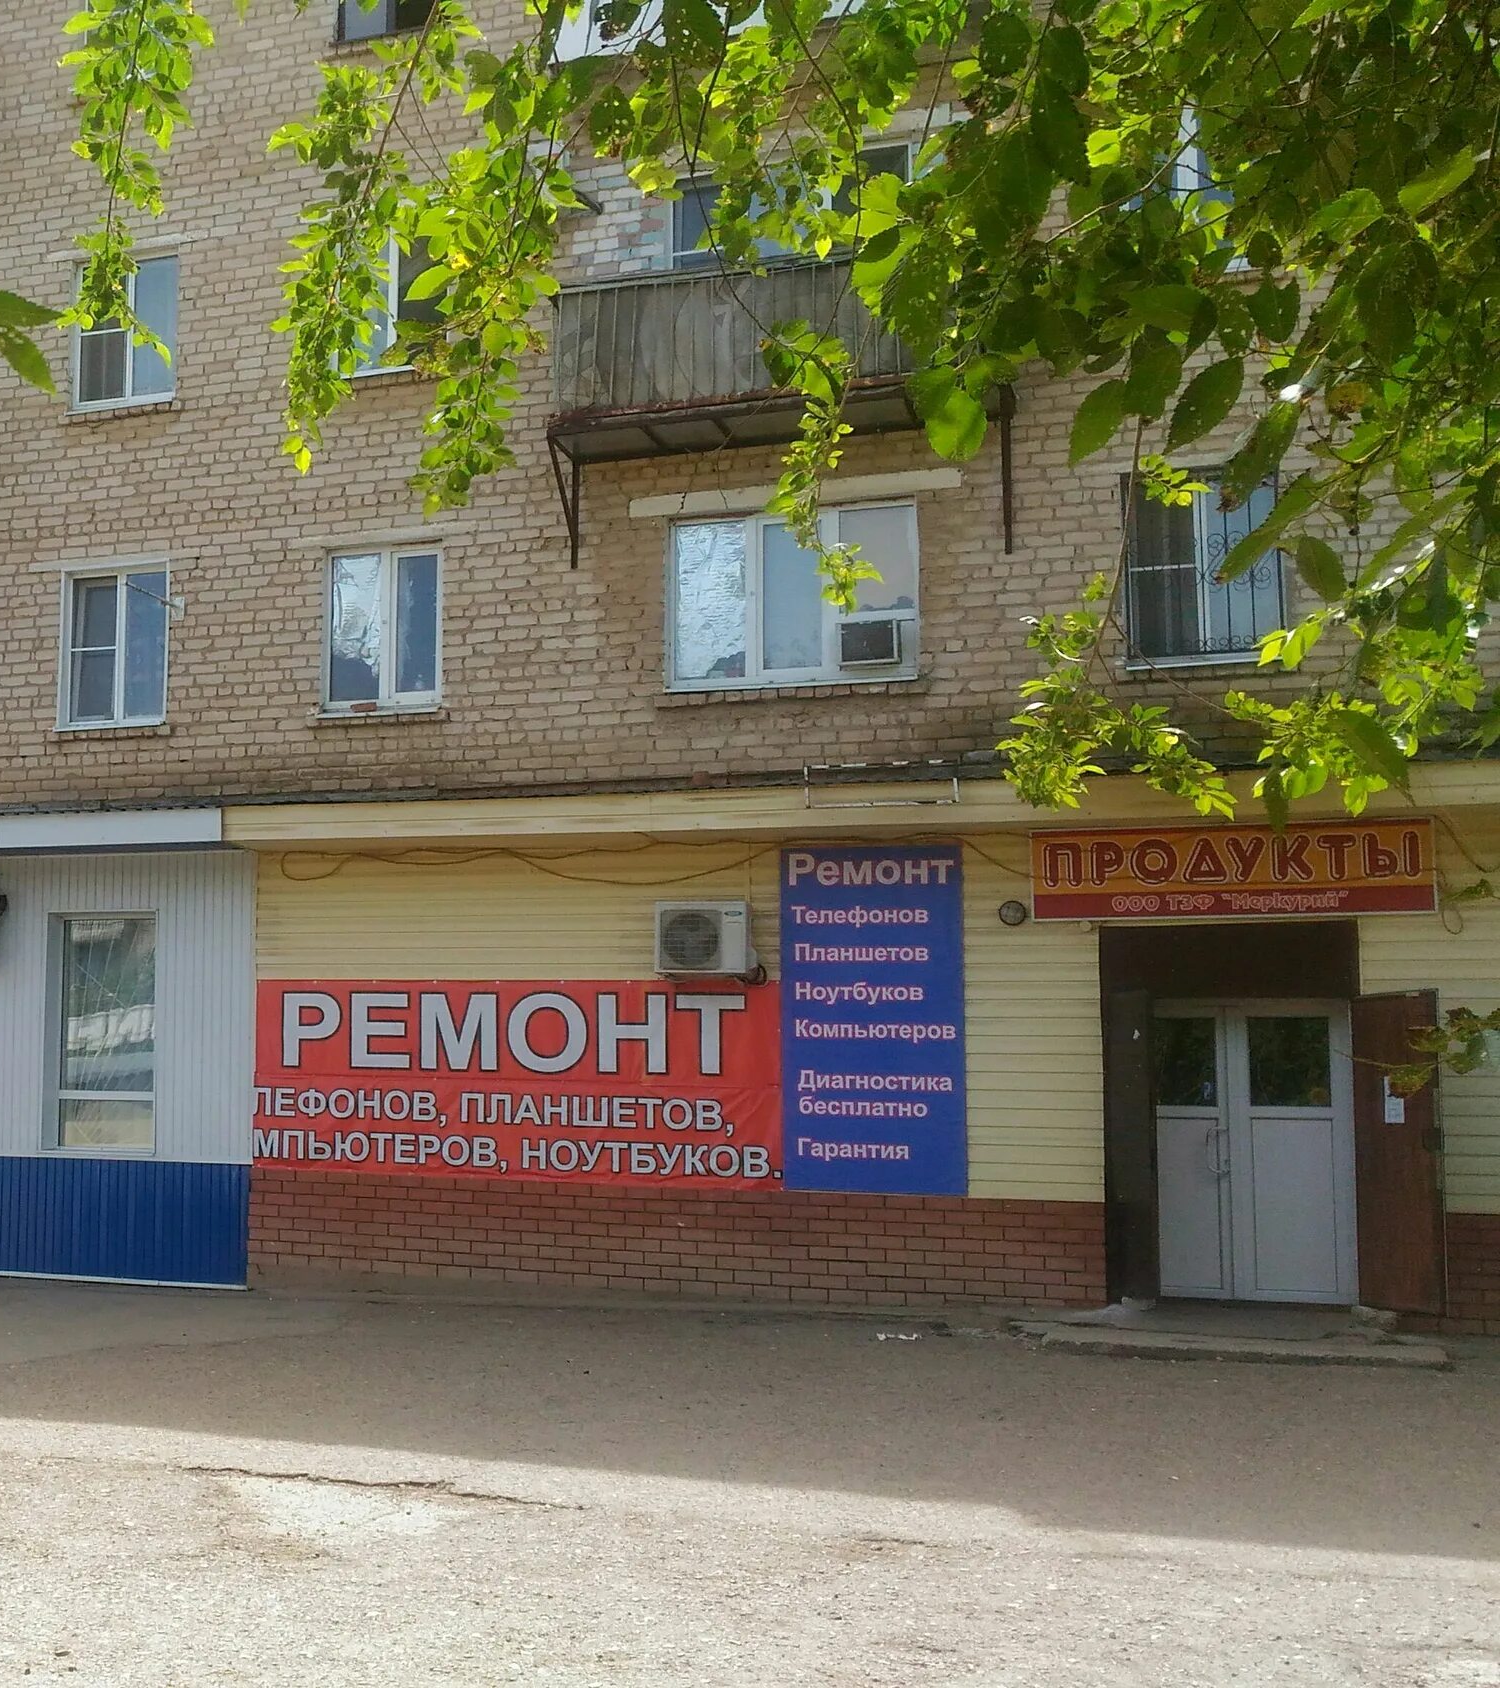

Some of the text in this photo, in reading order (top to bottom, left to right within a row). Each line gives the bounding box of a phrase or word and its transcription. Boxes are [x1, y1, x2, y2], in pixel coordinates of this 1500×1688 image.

[788, 853, 954, 887] Ремонт
[1042, 830, 1423, 888] ПРОДУКТЫ
[1111, 895, 1161, 912] ООО
[791, 905, 930, 928] Телефонов
[795, 943, 930, 962] Планшетов
[795, 981, 925, 1005] Ноутбуков
[282, 991, 746, 1076] РЕМОНТ
[795, 1019, 956, 1043] Компьютеров
[798, 1069, 953, 1092] Диагностика
[460, 1093, 735, 1137] ПЛАНШЕТОВ,
[799, 1095, 929, 1118] бесплатно
[521, 1138, 783, 1179] НОУТБУКОВ.
[797, 1137, 910, 1161] Гарантия
